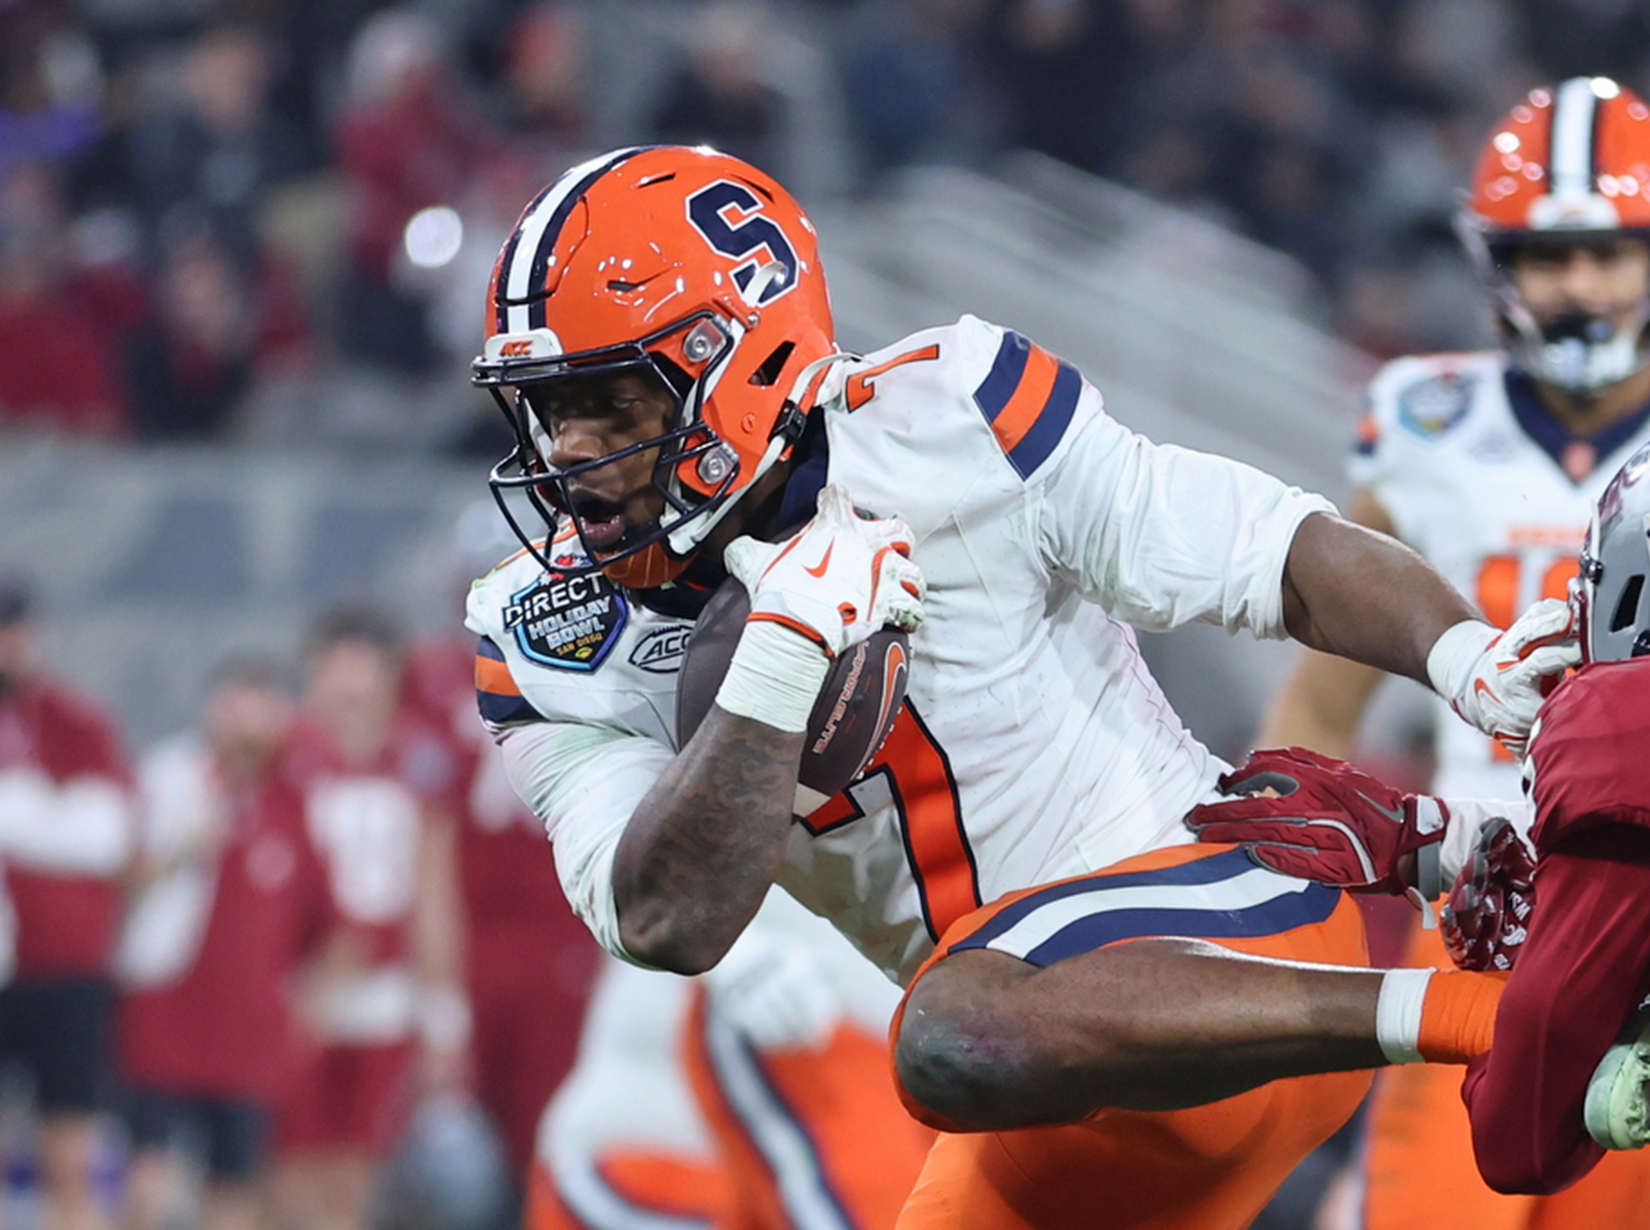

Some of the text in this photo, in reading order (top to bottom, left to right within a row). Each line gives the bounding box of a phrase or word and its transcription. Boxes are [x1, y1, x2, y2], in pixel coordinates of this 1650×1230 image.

[685, 178, 799, 309] S
[527, 594, 611, 640] HOLIDAY
[546, 617, 606, 650] BOWL
